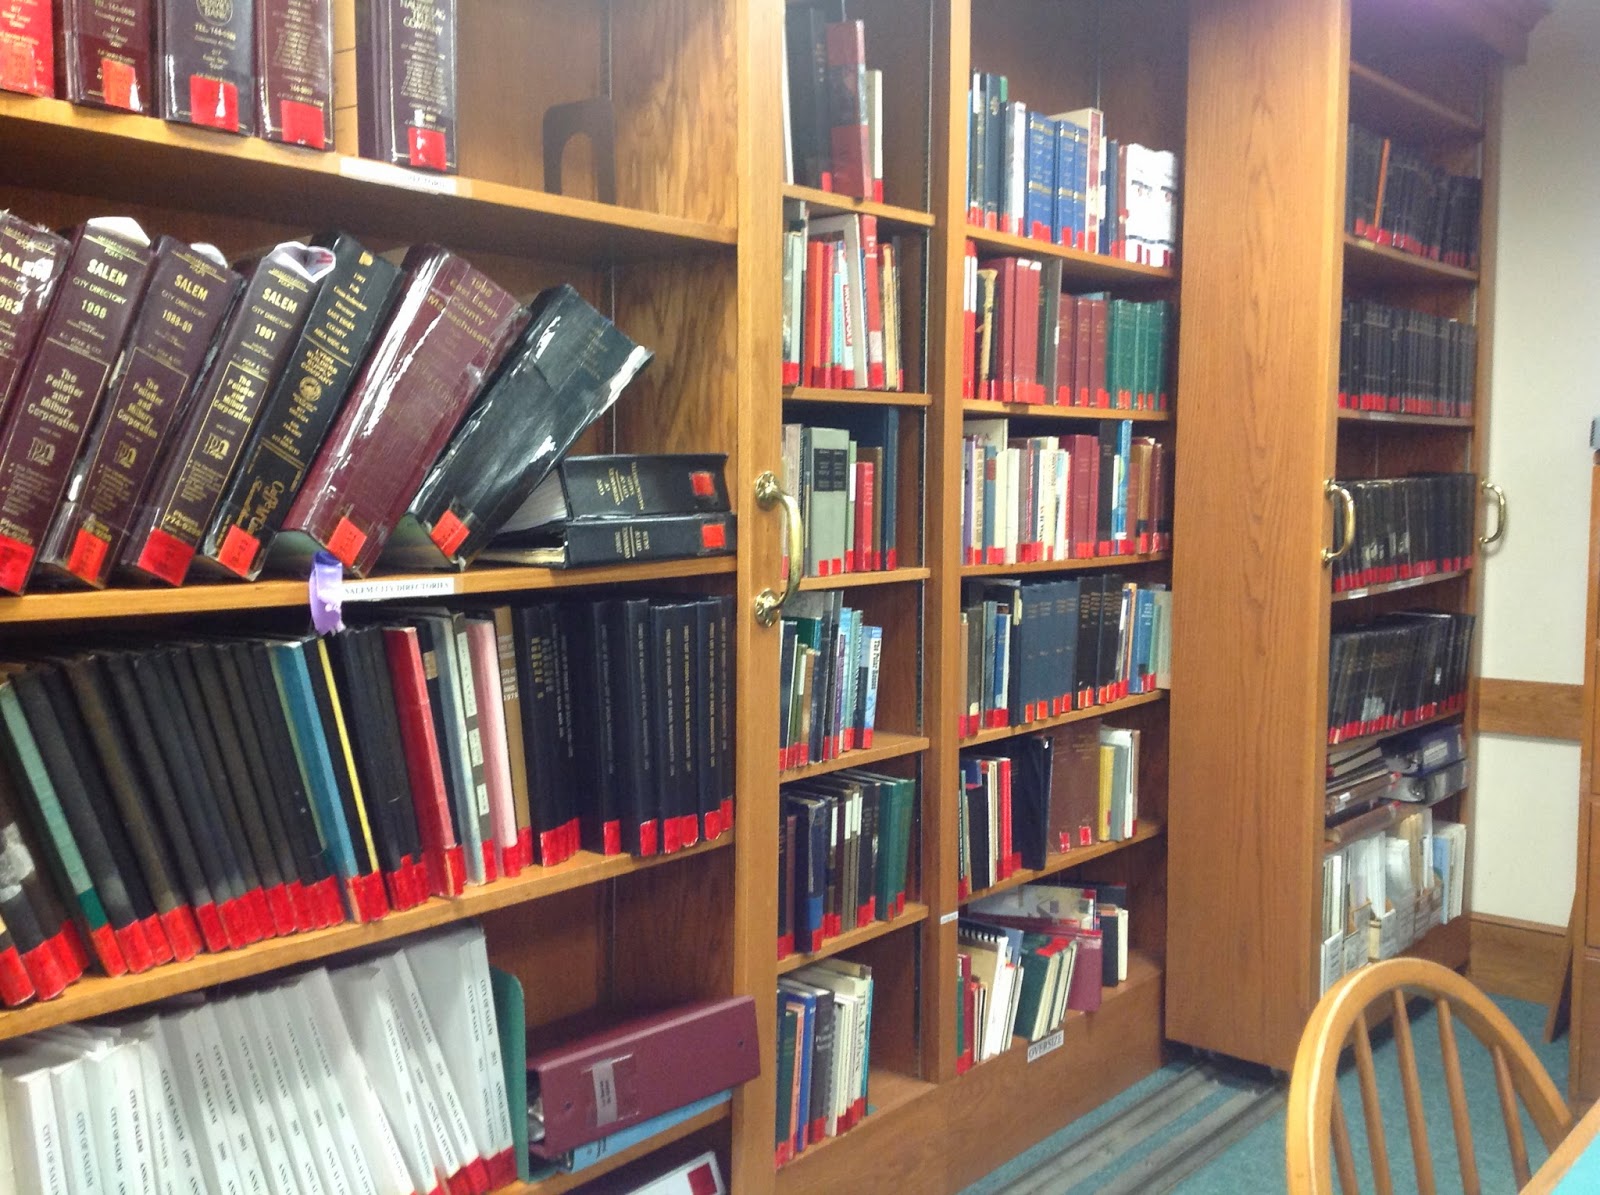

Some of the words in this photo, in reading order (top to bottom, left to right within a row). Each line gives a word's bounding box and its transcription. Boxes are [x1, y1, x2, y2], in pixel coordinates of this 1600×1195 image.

[87, 258, 129, 287] SALEM
[89, 282, 128, 305] DIRECTORY
[174, 273, 209, 302] SALEM
[262, 287, 298, 314] SALEM
[0, 294, 23, 315] 983
[451, 296, 485, 327] County
[844, 286, 853, 344] MONOPOLY
[254, 323, 277, 342] 1991
[264, 310, 293, 330] DIRECTORY
[61, 368, 78, 383] The
[145, 377, 160, 392] The
[239, 374, 252, 387] The
[301, 362, 334, 386] COMPANY
[52, 390, 70, 405] and
[27, 403, 80, 434] Corporation
[116, 408, 158, 439] Corporation
[213, 400, 252, 424] Corporation
[345, 586, 373, 595] SALEM
[397, 581, 449, 592] DIRECTORIES
[470, 1002, 476, 1014] OF
[482, 997, 489, 1010] OF
[472, 1014, 480, 1042] SALEM
[485, 1010, 493, 1036] SALEM
[1029, 1033, 1062, 1059] OVERSIZE
[240, 1035, 249, 1057] CITY
[248, 1059, 254, 1070] OF
[252, 1072, 264, 1105] SALEM
[265, 1035, 274, 1056] CITY
[276, 1069, 288, 1098] SALEM
[394, 1047, 404, 1073] SALEM
[420, 1020, 433, 1044] SALEM
[446, 1092, 459, 1121] ANNUAL
[195, 1052, 204, 1075] CITY
[201, 1077, 209, 1089] OF
[206, 1091, 218, 1125] SALEM
[213, 1044, 223, 1067] CITY
[220, 1069, 228, 1081] OF
[224, 1083, 237, 1115] SALEM
[129, 1089, 137, 1109] CITY
[162, 1069, 171, 1092] CITY
[167, 1094, 175, 1106] OF
[173, 1108, 185, 1141] SALEM
[286, 1022, 296, 1043] CITY
[297, 1058, 310, 1089] SALEM
[326, 1147, 340, 1180] ANNUAL
[482, 1088, 492, 1119] ANNUAL
[495, 1081, 505, 1110] ANNUAL
[76, 1111, 86, 1135] CITY
[110, 1106, 118, 1128] CITY
[133, 1110, 139, 1122] OF
[42, 1124, 52, 1148] CITY
[47, 1151, 54, 1163] OF
[80, 1137, 88, 1150] OF
[113, 1128, 119, 1140] OF
[134, 1124, 143, 1153] SALEM
[428, 1101, 441, 1129] ANNUAL
[438, 1129, 453, 1166] LISTING
[82, 1152, 94, 1188] SALEM
[114, 1142, 123, 1172] SALEM
[351, 1144, 364, 1174] ANNUAL
